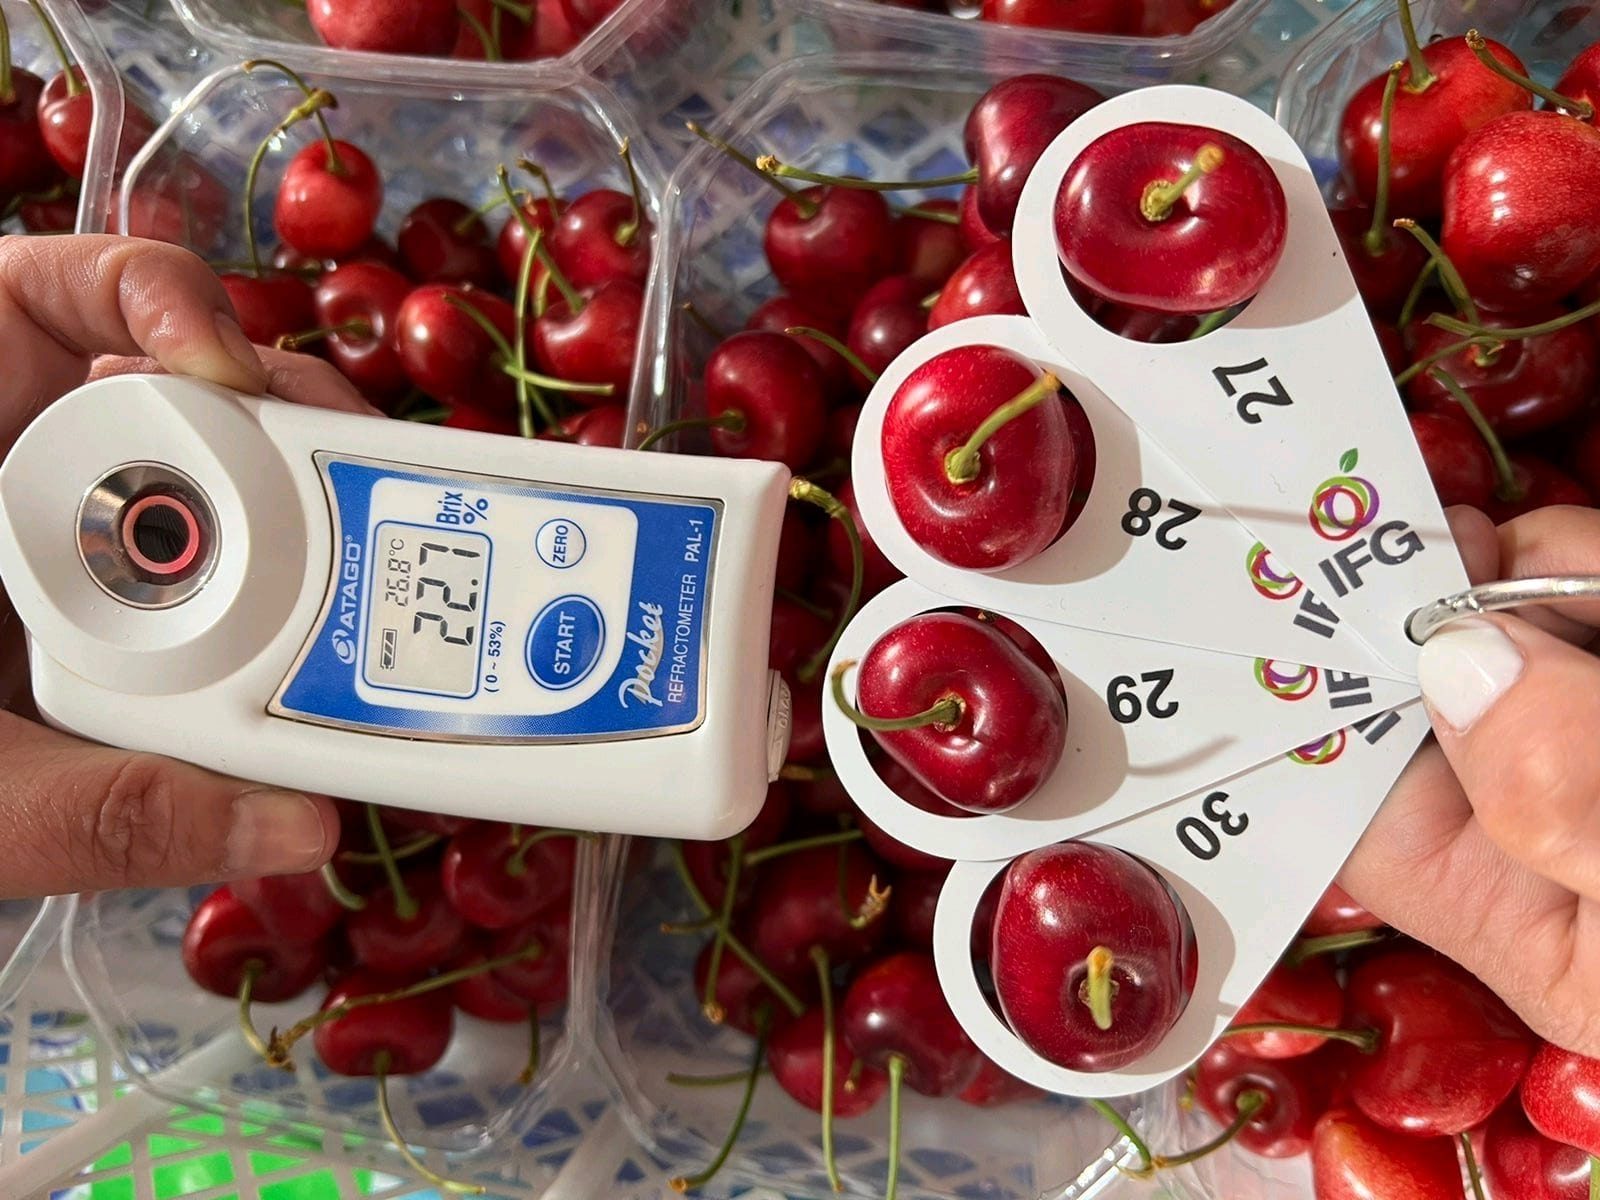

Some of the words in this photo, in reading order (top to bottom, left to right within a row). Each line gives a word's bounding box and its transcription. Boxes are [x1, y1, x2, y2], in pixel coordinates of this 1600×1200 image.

[1212, 357, 1293, 424] 27
[436, 491, 463, 525] Brix
[462, 498, 489, 525] %
[1121, 487, 1202, 550] 28
[553, 525, 568, 563] ZERO
[684, 519, 703, 562] PAL-1
[1318, 520, 1425, 598] IFG
[413, 542, 480, 646] 22.7
[1293, 588, 1340, 639] IF
[554, 611, 577, 675] START
[618, 601, 663, 708] Pocket
[667, 573, 697, 703] REFRACTOMETER
[1106, 668, 1179, 724] 29
[1324, 668, 1372, 709] IF
[1176, 791, 1249, 860] 30
